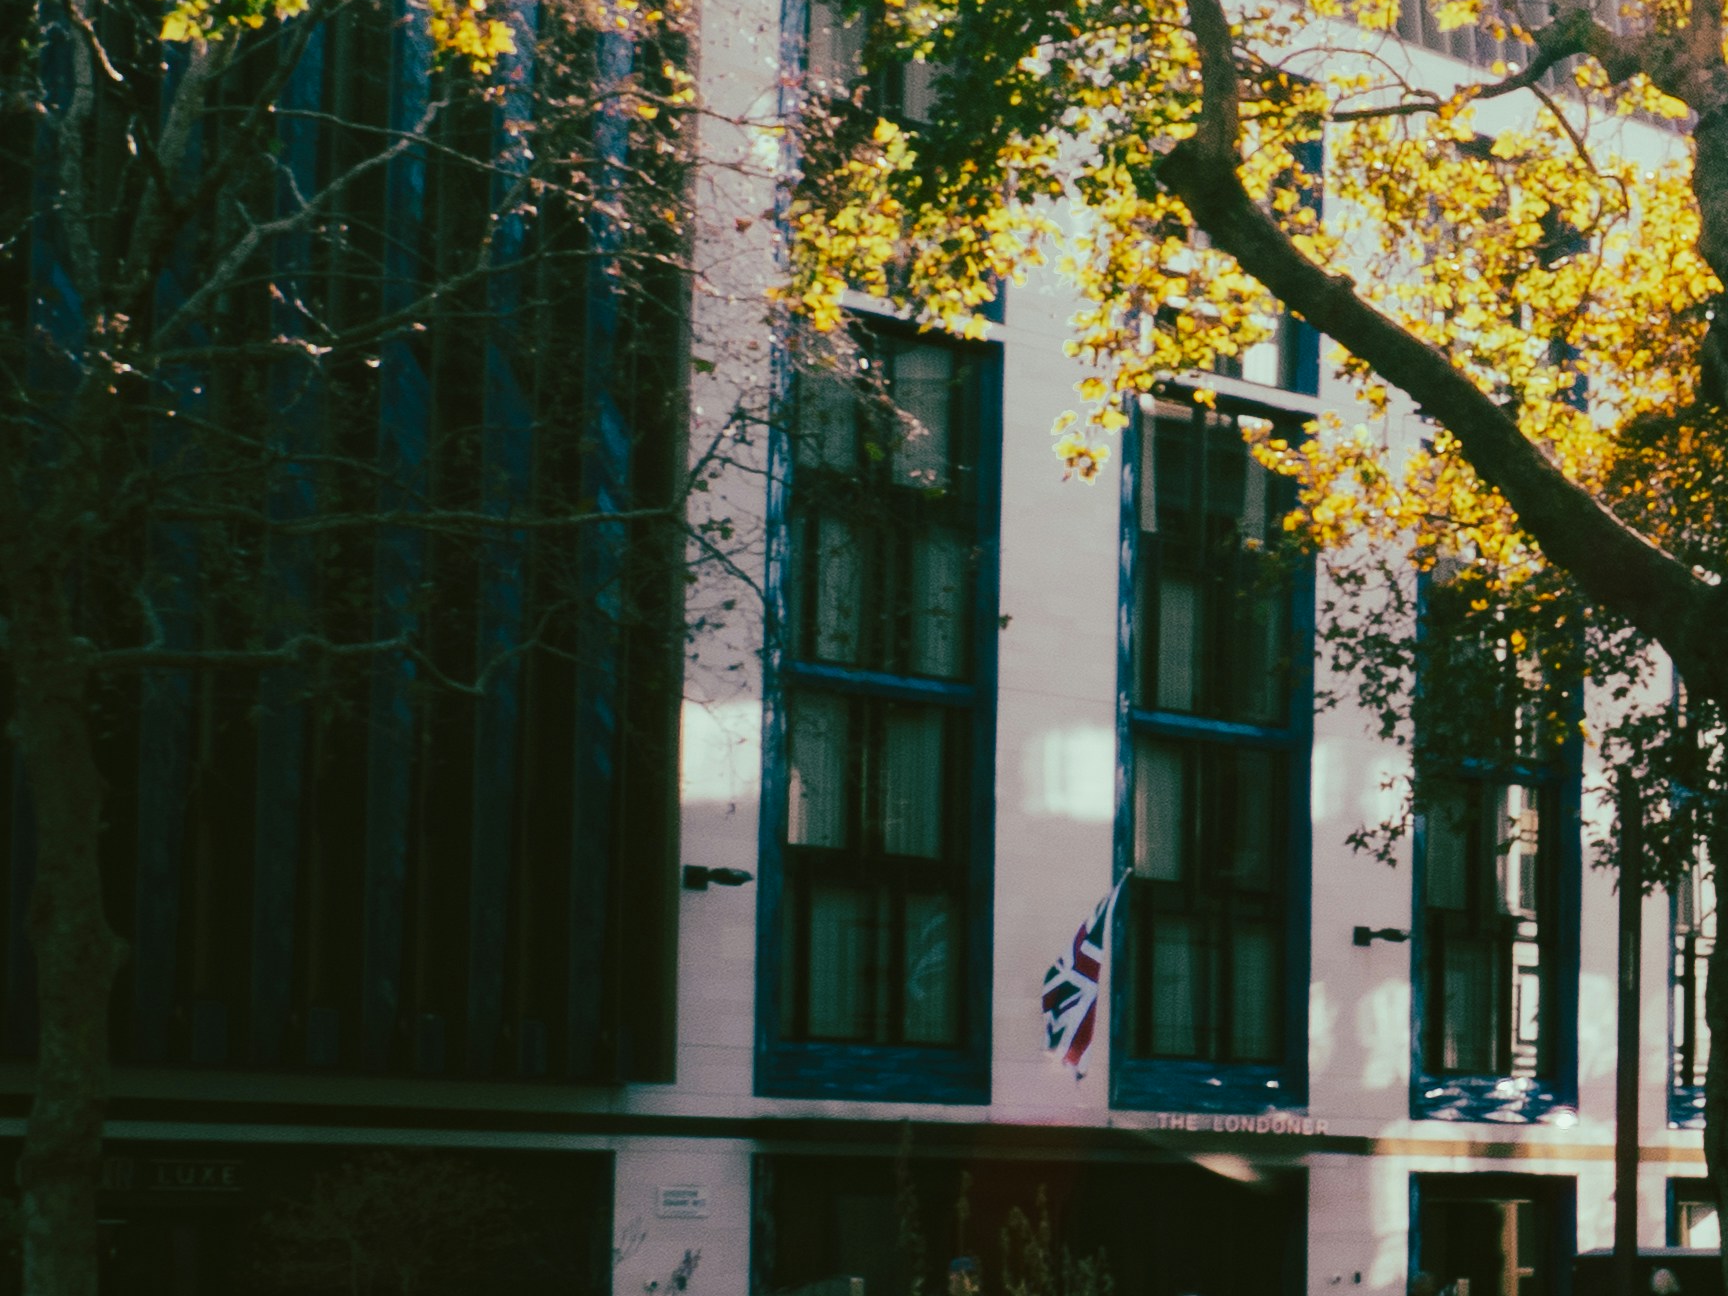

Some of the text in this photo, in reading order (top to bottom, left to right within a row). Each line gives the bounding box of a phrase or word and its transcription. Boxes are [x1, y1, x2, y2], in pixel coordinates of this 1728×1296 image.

[1156, 1112, 1330, 1135] THE LONDONER
[156, 1165, 237, 1186] LUXE
